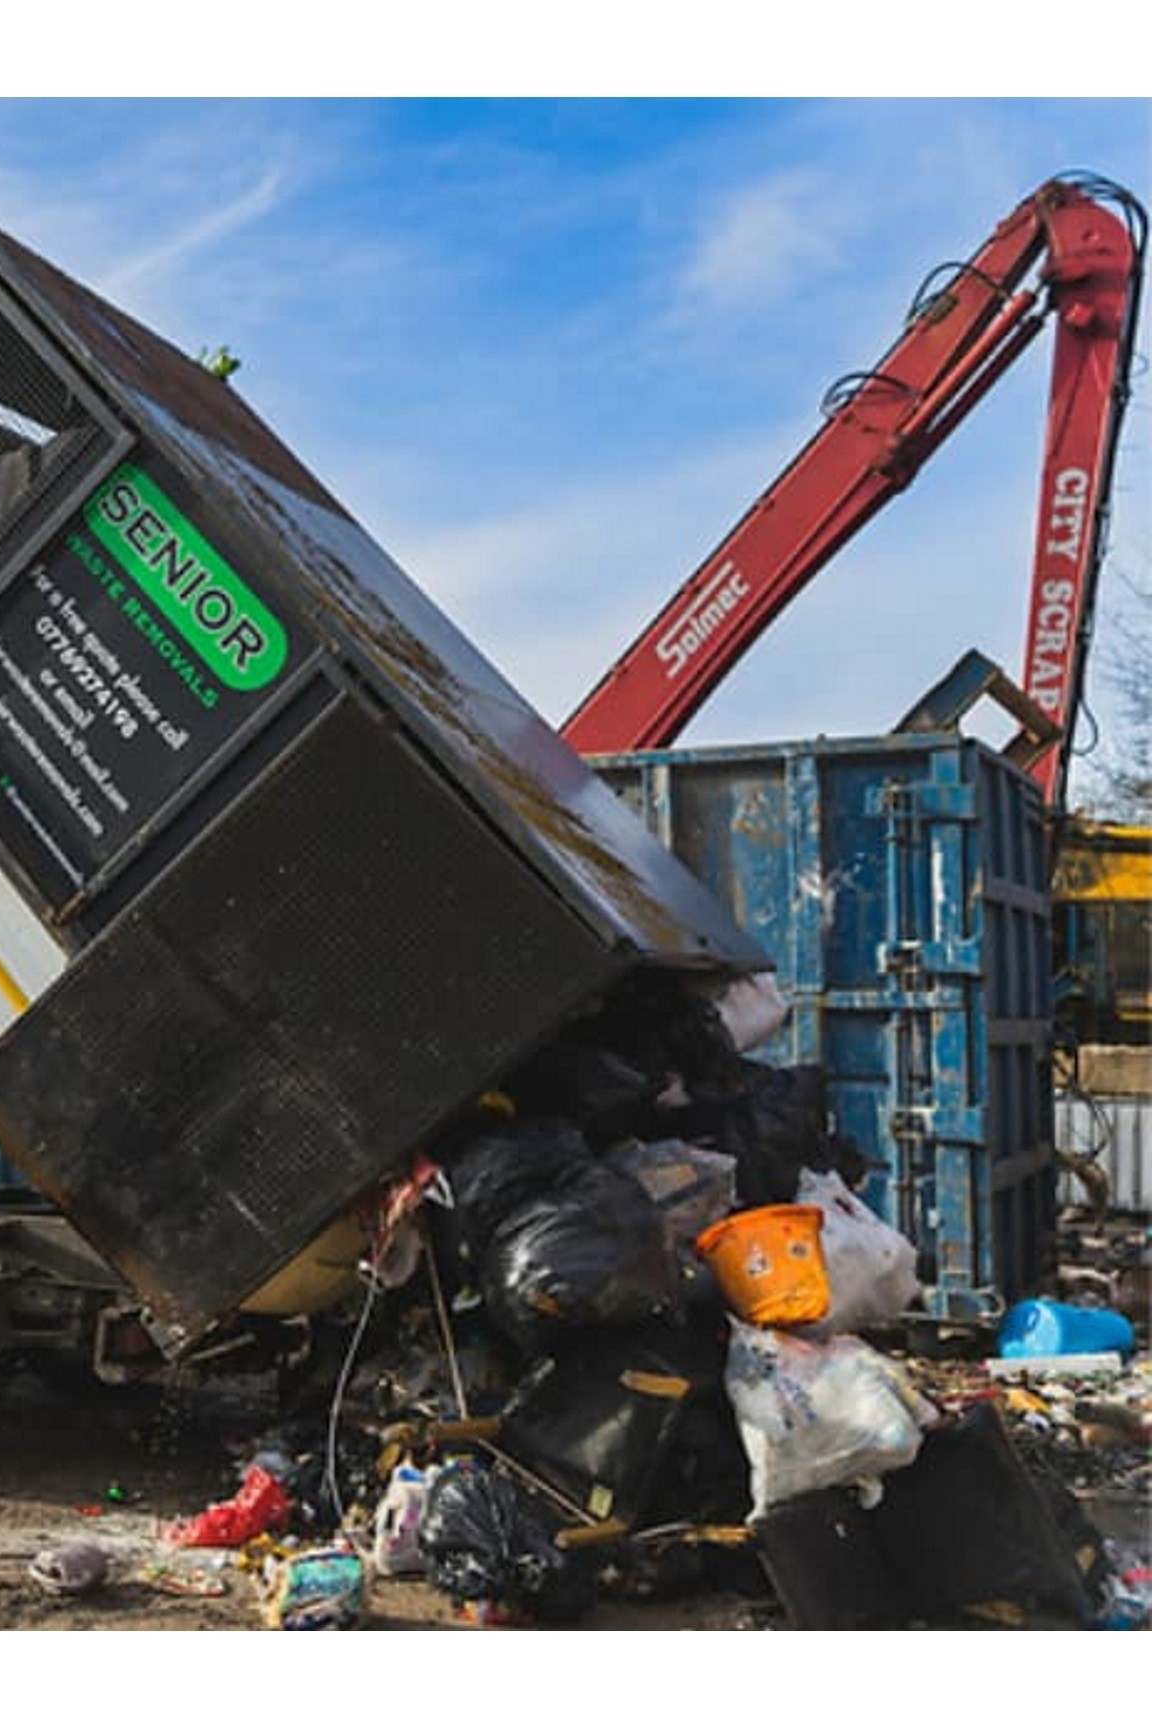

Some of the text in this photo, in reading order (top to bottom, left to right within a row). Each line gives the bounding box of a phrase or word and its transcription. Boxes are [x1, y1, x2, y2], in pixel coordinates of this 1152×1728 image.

[99, 483, 267, 675] SENIOR
[655, 560, 750, 680] Solmec
[1030, 468, 1089, 711] CITY SCRAP
[53, 686, 95, 729] email
[60, 597, 87, 635] free
[82, 632, 121, 675] quote
[113, 673, 161, 722] please
[156, 720, 190, 750] call
[121, 597, 219, 709] REMOVALS
